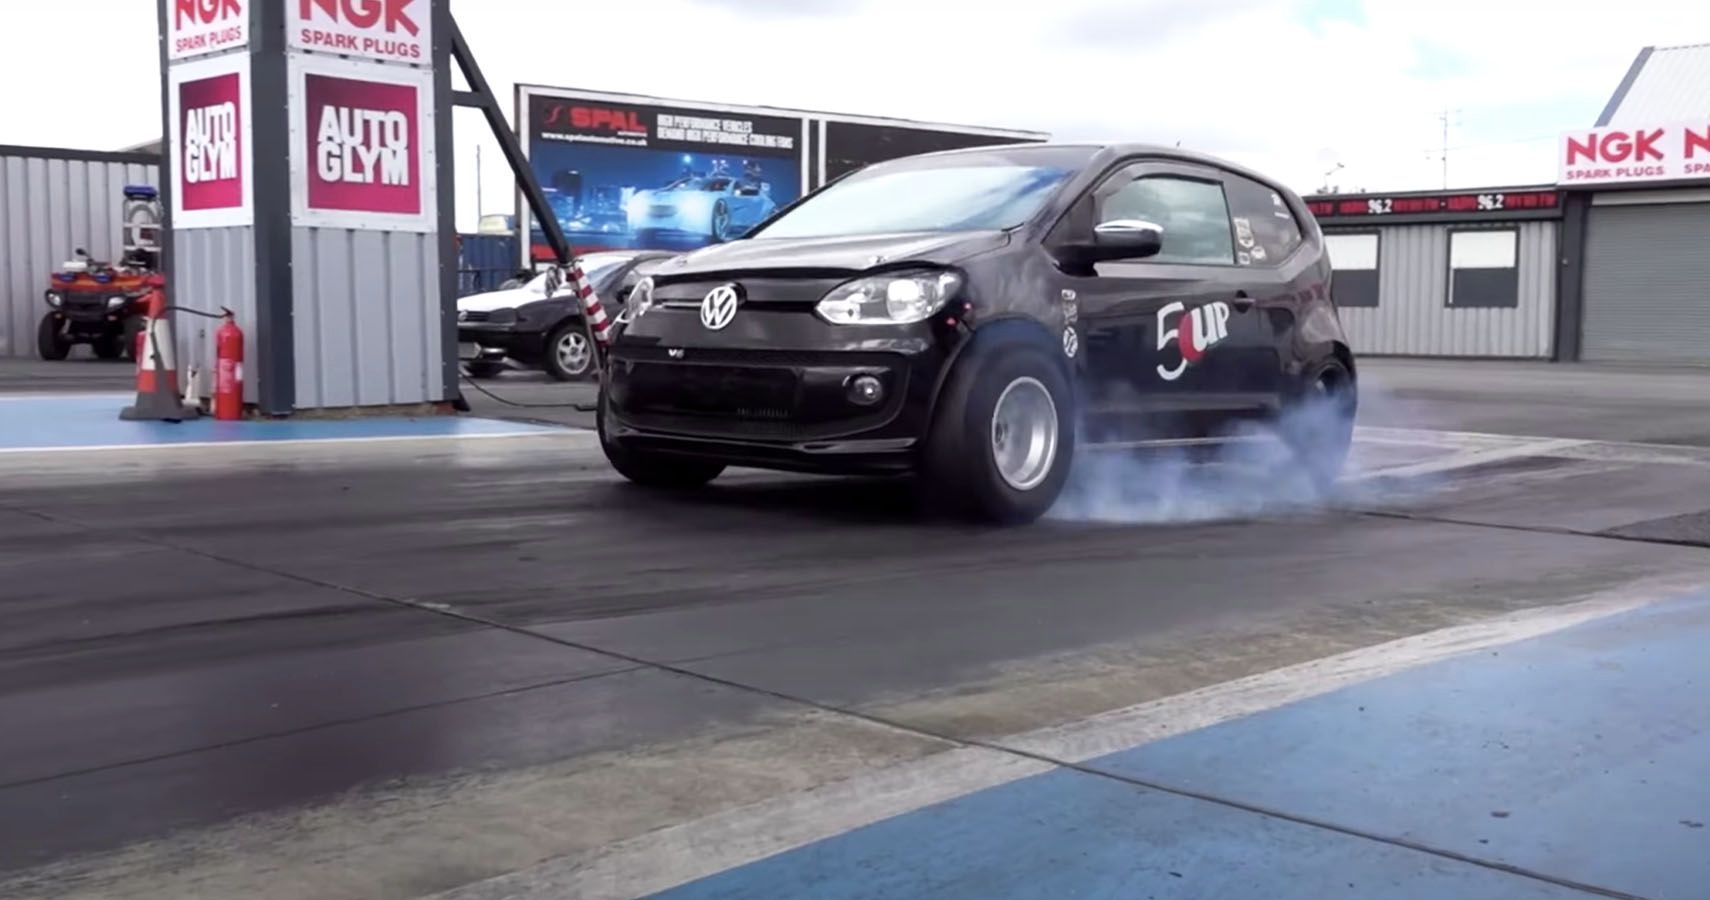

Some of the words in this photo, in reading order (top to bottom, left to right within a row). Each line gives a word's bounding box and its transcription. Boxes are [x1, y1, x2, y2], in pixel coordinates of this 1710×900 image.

[176, 34, 207, 52] SPARK
[210, 25, 241, 48] PLUGS
[301, 28, 358, 50] SPARK
[363, 37, 420, 58] PLUGS
[185, 101, 236, 145] AUTO
[318, 105, 408, 150] AUTO
[570, 107, 648, 132] SPAL
[185, 139, 237, 183] GLYM
[1566, 128, 1665, 165] NGK
[317, 141, 409, 186] GLYM
[1566, 169, 1612, 179] SPARK
[1616, 166, 1665, 177] PLUGS
[1684, 163, 1710, 174] SPA
